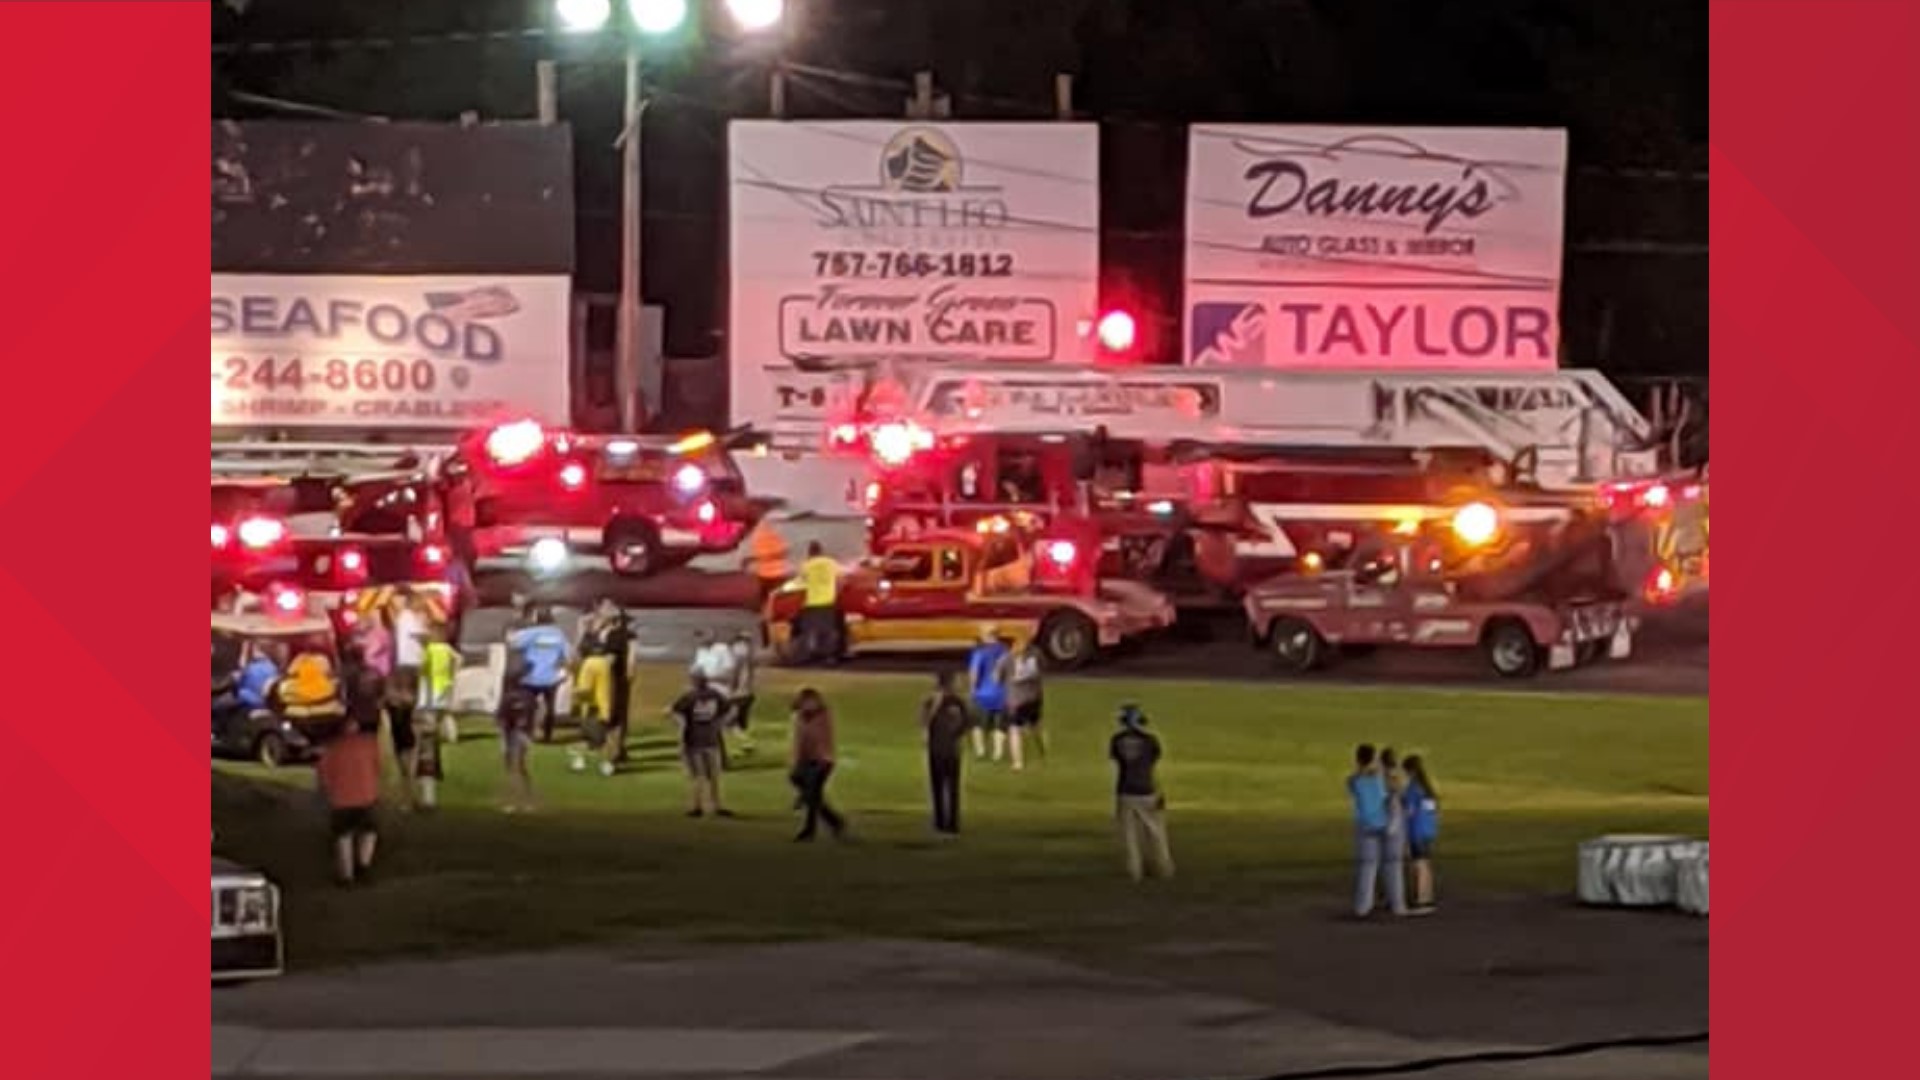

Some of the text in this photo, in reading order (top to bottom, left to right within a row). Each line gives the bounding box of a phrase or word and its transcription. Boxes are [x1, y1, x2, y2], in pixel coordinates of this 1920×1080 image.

[1244, 160, 1494, 234] Danny's
[1261, 235, 1312, 255] AUTO
[1317, 236, 1380, 255] GLASS
[211, 296, 504, 362] SEAFOOD
[799, 317, 1037, 345] LAWN CARE
[1279, 302, 1552, 358] TAYLOR
